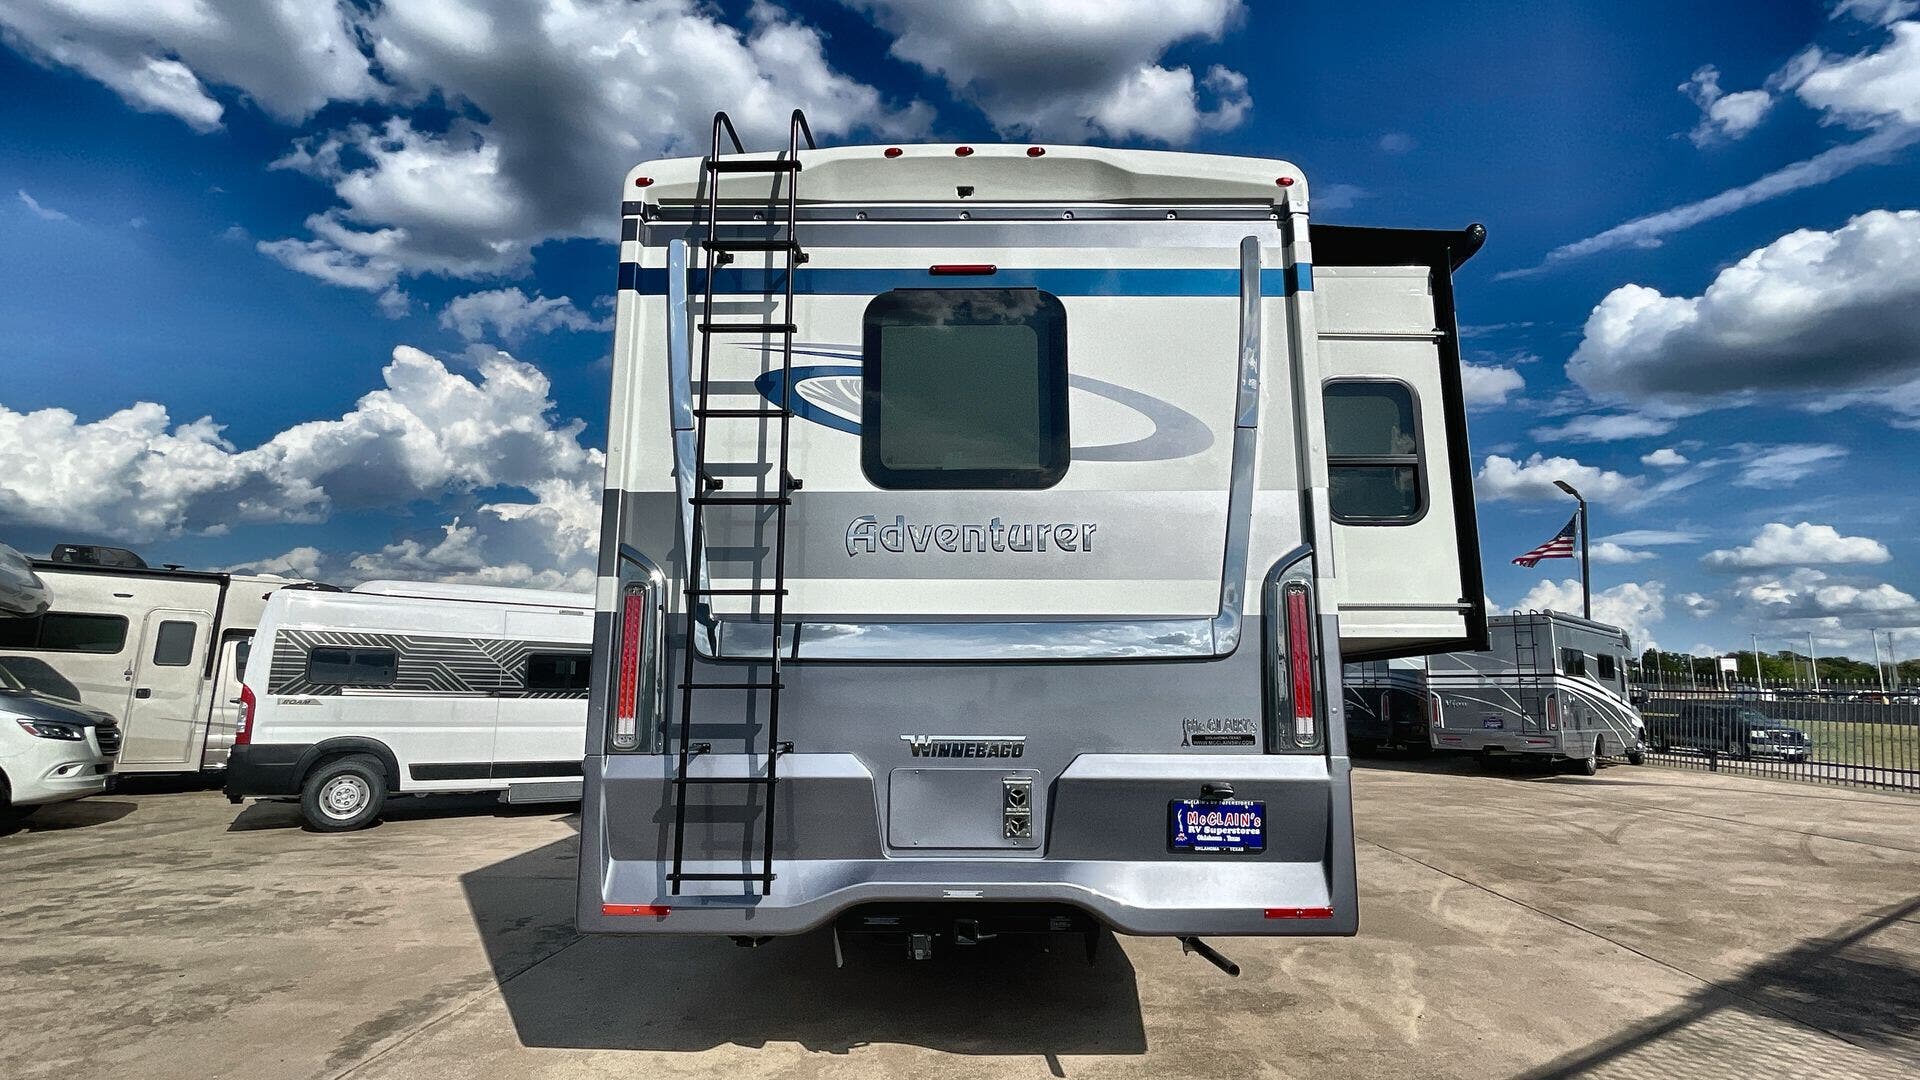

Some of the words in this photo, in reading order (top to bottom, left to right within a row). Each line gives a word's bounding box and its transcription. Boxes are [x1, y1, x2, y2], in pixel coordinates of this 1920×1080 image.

[845, 514, 1097, 557] Adventurer
[900, 735, 1026, 758] WINNEBAGO
[1187, 811, 1261, 827] McCLAIN's
[1188, 826, 1202, 834] RV
[1203, 826, 1260, 835] Superstores
